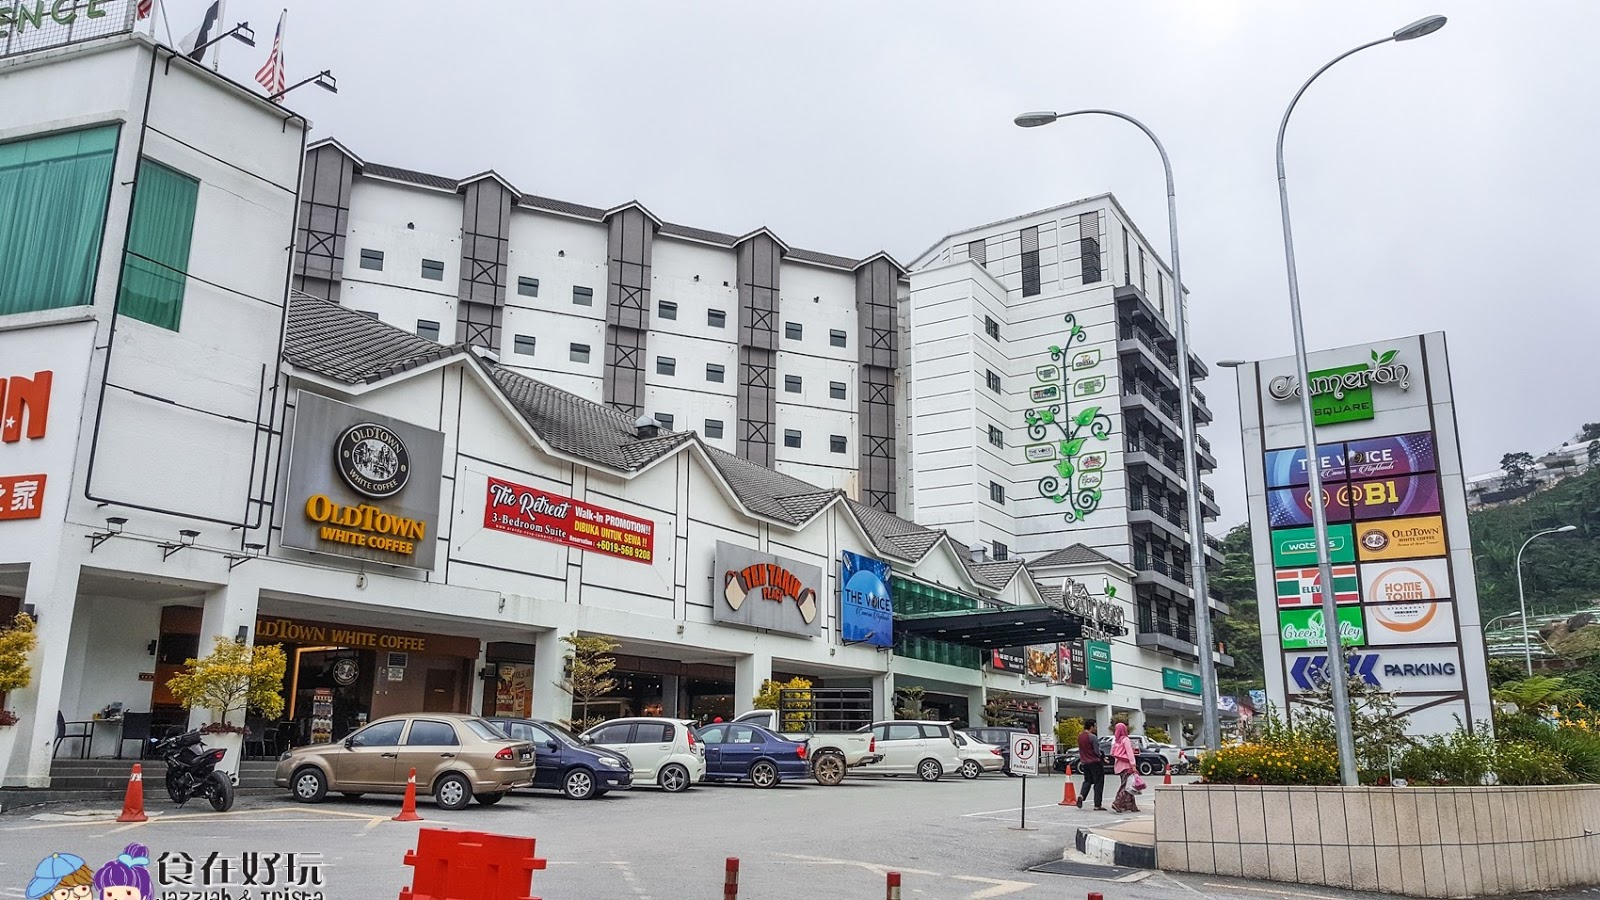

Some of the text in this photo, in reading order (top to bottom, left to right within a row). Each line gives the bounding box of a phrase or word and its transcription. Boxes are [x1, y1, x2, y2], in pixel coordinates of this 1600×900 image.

[1314, 402, 1369, 416] SQUARE
[1298, 456, 1331, 470] TE
[350, 469, 398, 491] WHITE COFFEE
[490, 484, 572, 520] The Retreat
[491, 512, 543, 533] 3-Bedroom
[545, 525, 567, 538] Suite
[575, 521, 599, 536] DIBUKA
[601, 527, 622, 541] UNTUK
[624, 533, 641, 546] SEWA
[320, 527, 413, 555] WHITE COFFEE
[596, 540, 633, 556] +6019-568
[634, 548, 651, 560] 9208
[1288, 540, 1336, 551] watss
[741, 563, 802, 602] TEH TARIK
[1385, 582, 1422, 593] HOME
[761, 587, 783, 603] PLACE
[845, 589, 890, 611] THE VOICE
[256, 619, 425, 650] LDTOWN WHITE COFFEE
[1284, 625, 1317, 639] Green
[1384, 662, 1456, 677] PARKING
